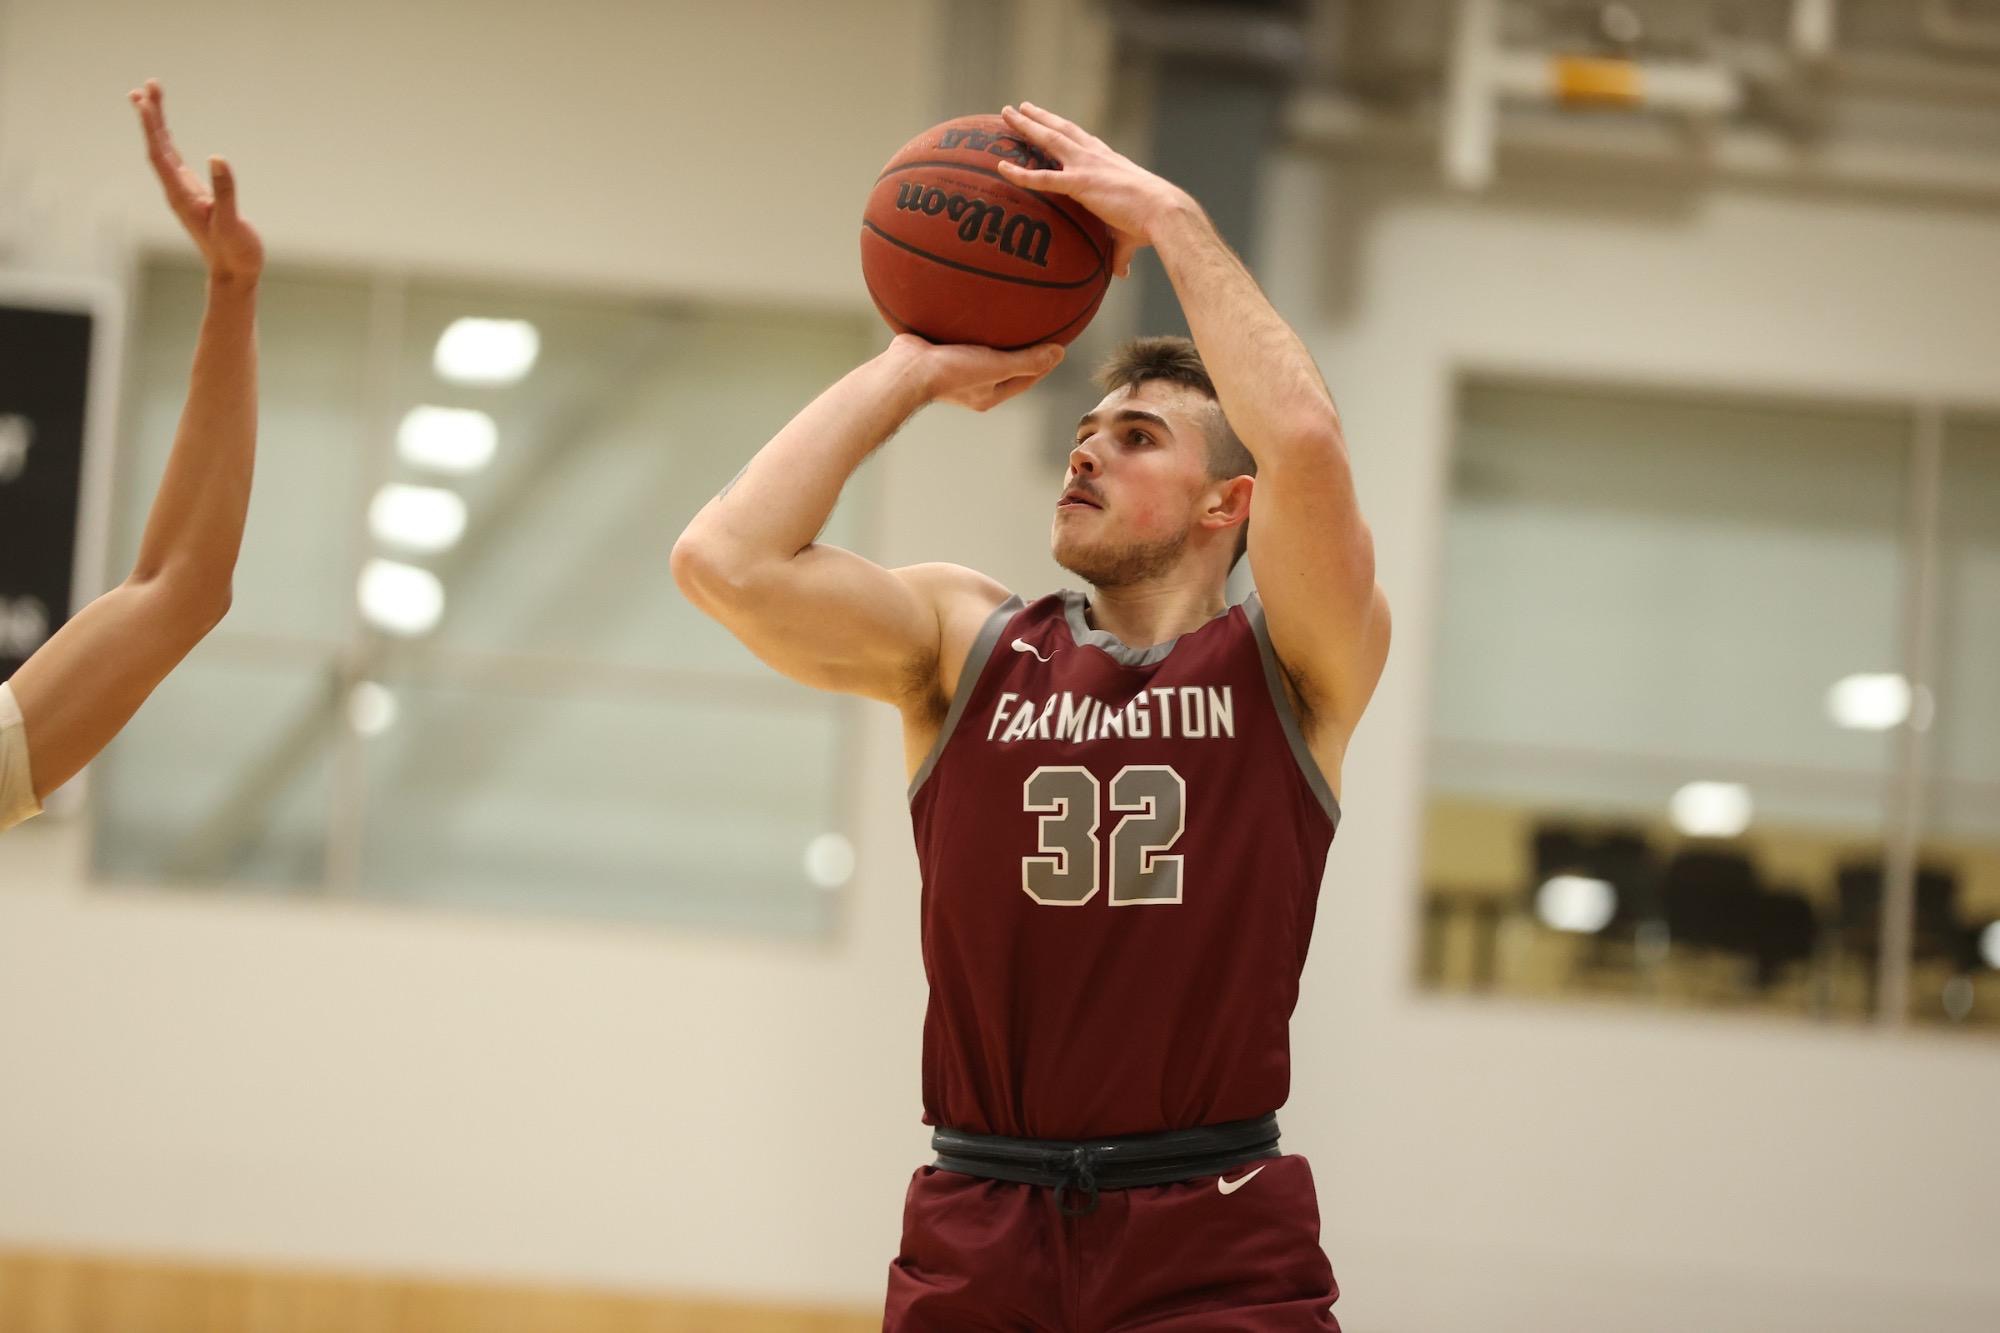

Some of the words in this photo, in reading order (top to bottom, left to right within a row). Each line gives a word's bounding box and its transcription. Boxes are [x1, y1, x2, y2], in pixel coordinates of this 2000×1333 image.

[896, 182, 1052, 268] Wilson
[986, 685, 1236, 744] FARMINGTON
[1021, 764, 1187, 907] 32
